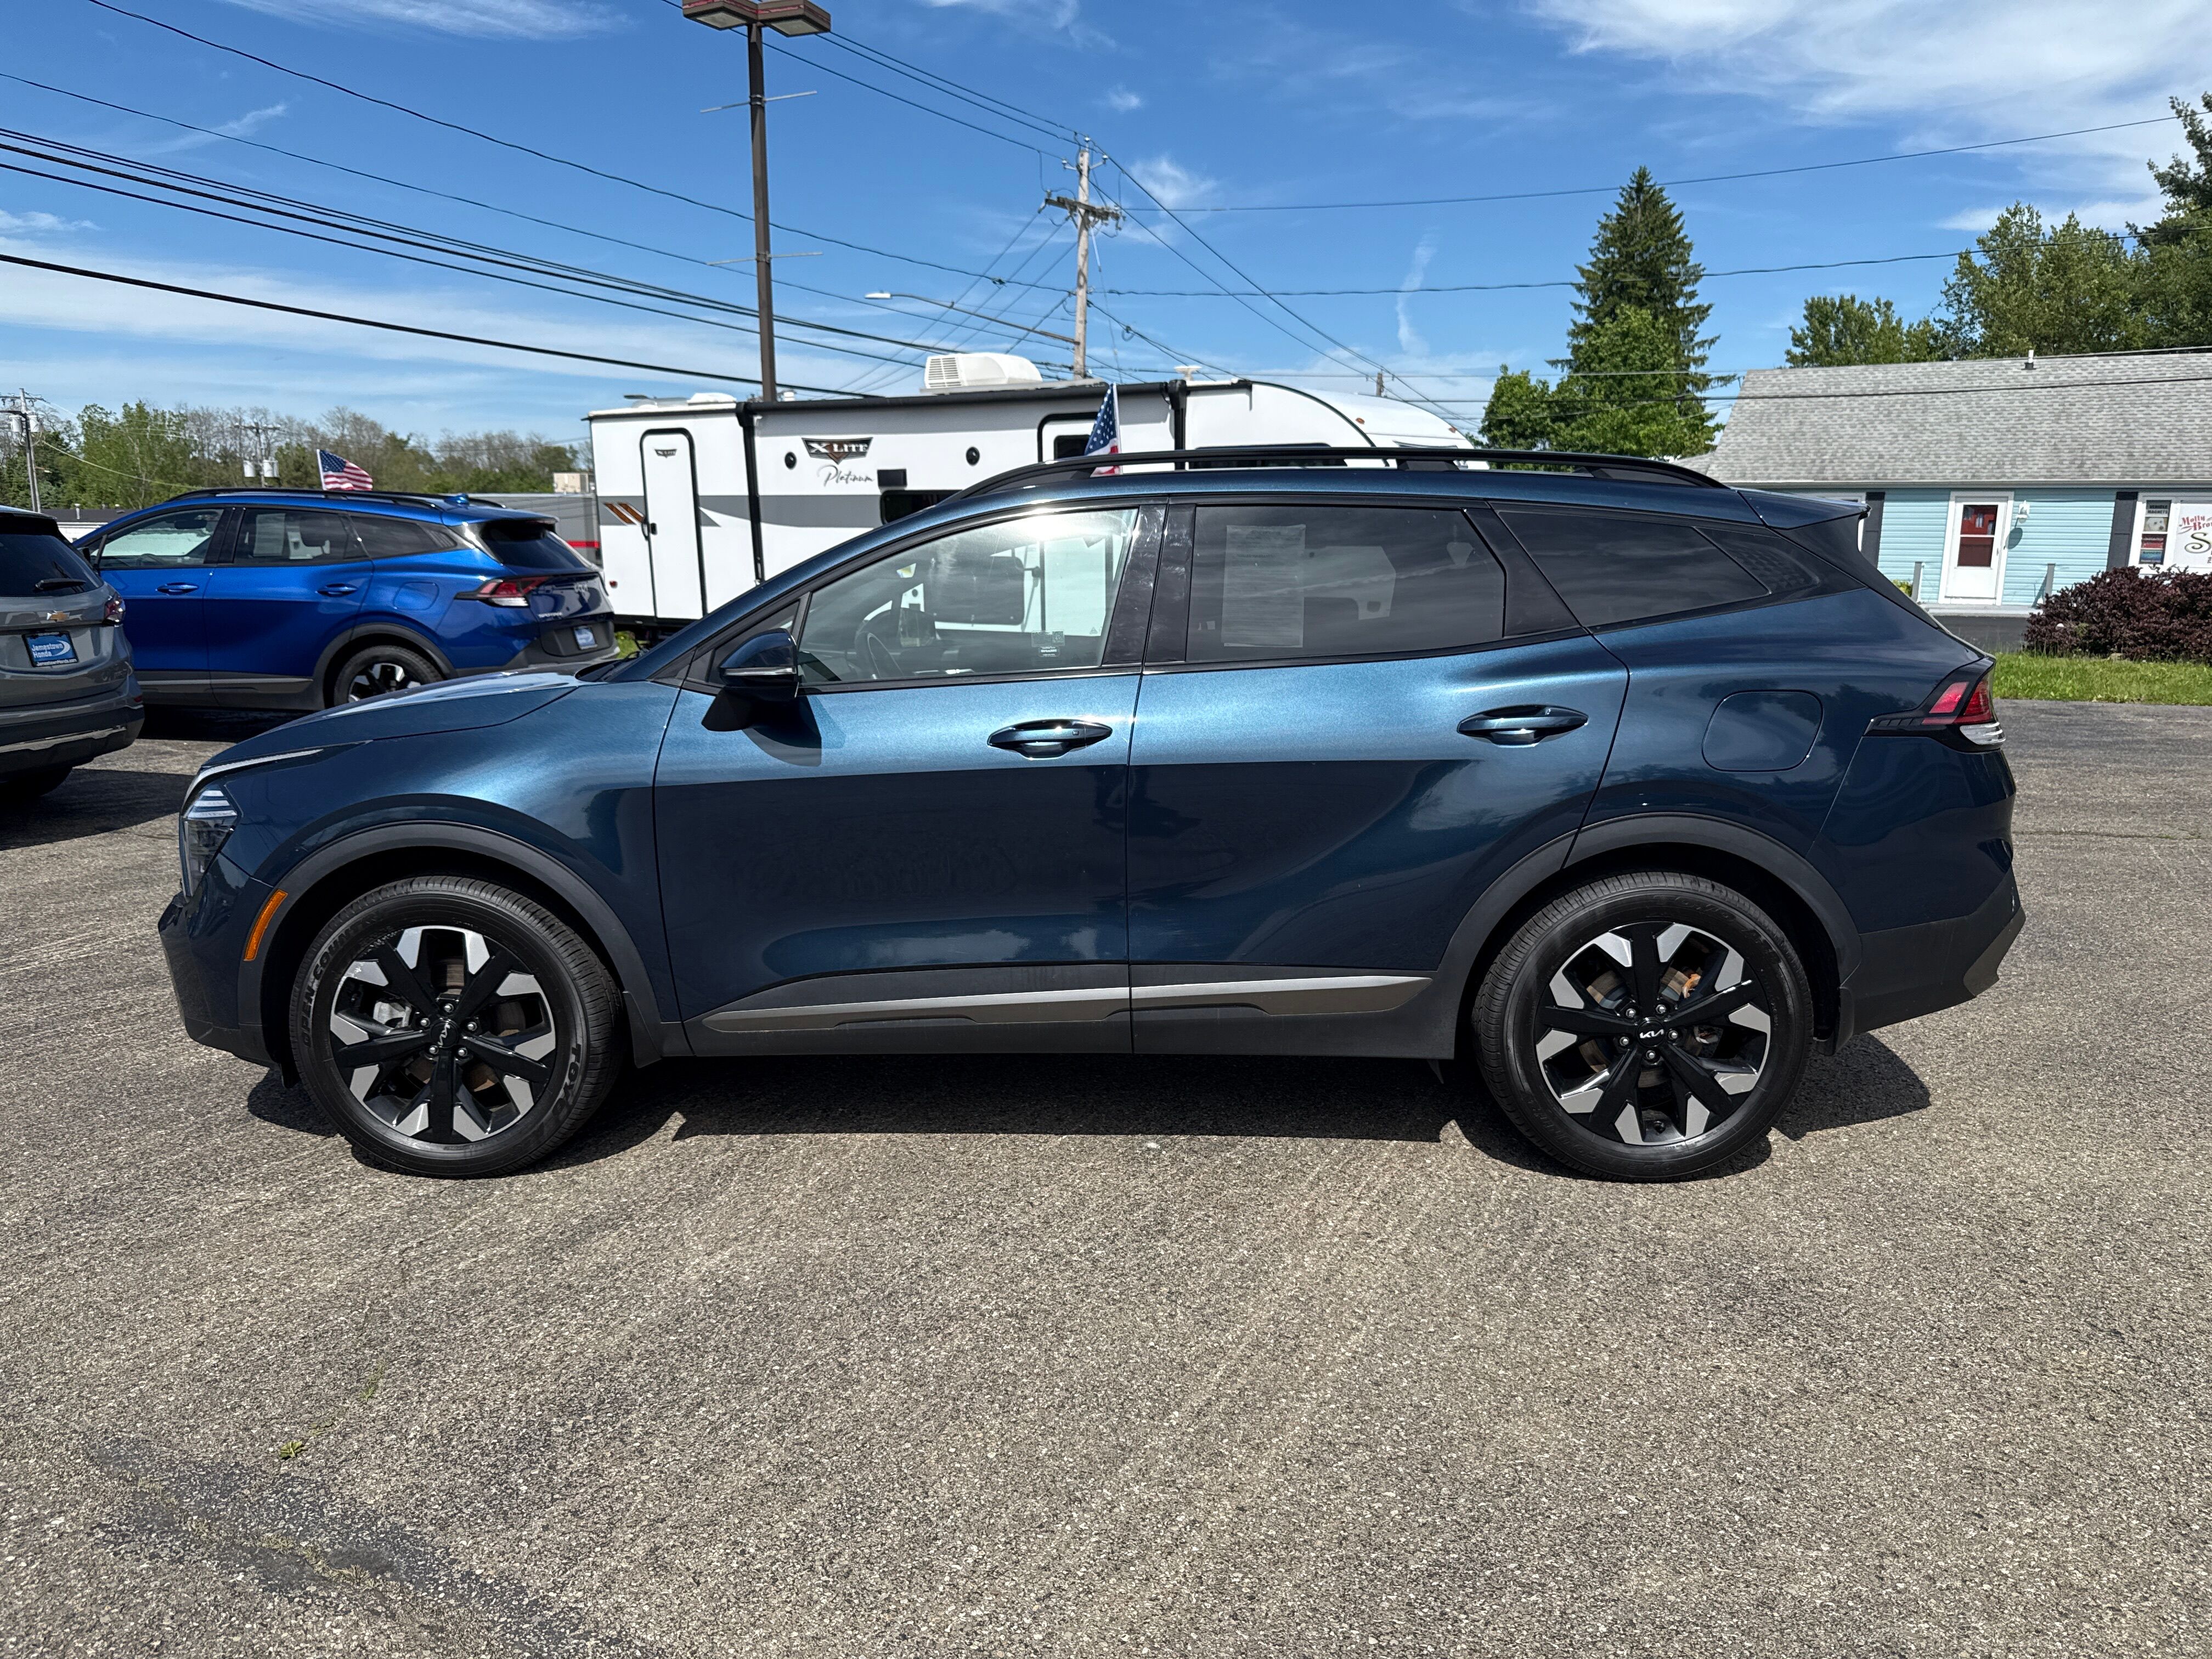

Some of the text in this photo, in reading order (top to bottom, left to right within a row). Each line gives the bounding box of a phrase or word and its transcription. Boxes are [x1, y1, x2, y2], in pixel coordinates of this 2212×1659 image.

[808, 442, 868, 453] X LITE
[816, 464, 874, 487] Platinum
[2179, 516, 2205, 527] Molly
[31, 643, 64, 651] Jamestown
[33, 650, 52, 658] Honda
